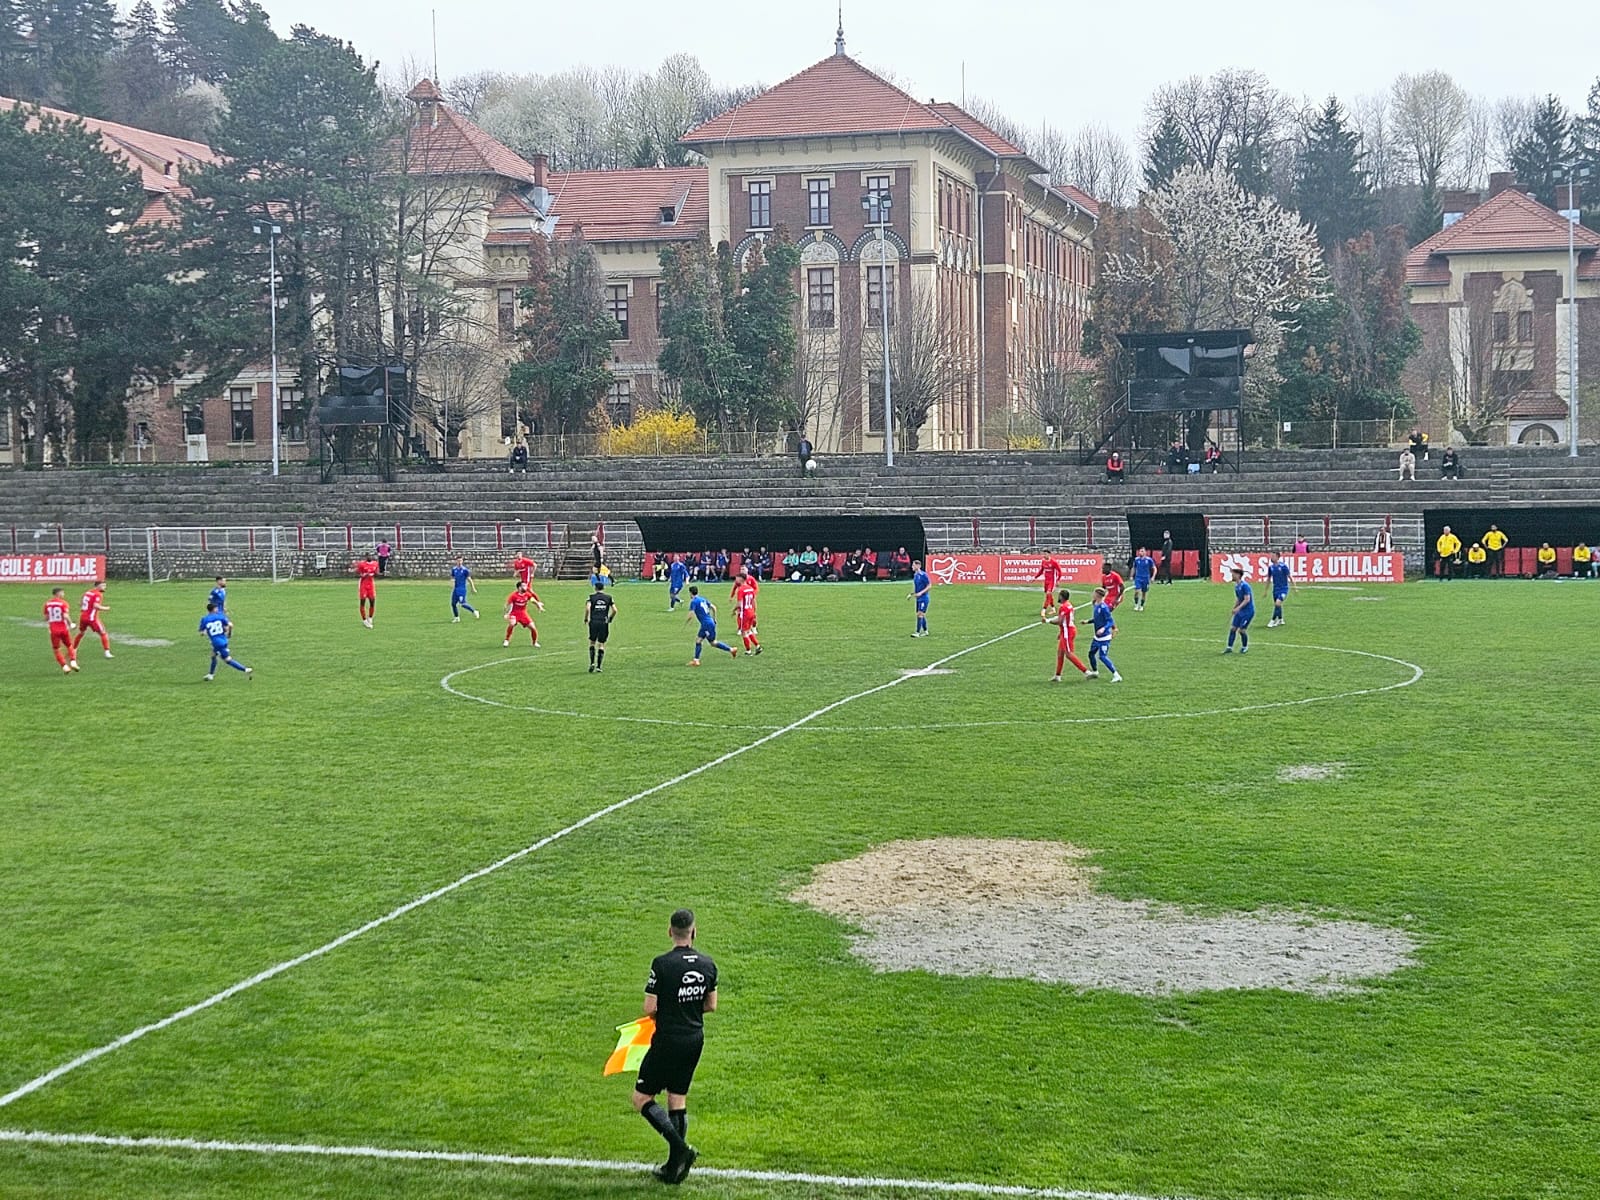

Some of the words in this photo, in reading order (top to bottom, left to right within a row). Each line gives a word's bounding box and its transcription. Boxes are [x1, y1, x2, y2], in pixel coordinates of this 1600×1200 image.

[0, 558, 31, 576] CULE
[34, 560, 44, 576] &
[46, 558, 97, 576] UTILAJE
[1311, 558, 1323, 576] &
[1328, 556, 1393, 576] UTILAJE
[47, 606, 62, 622] 18
[206, 620, 224, 636] 28
[678, 985, 706, 997] MOOV
